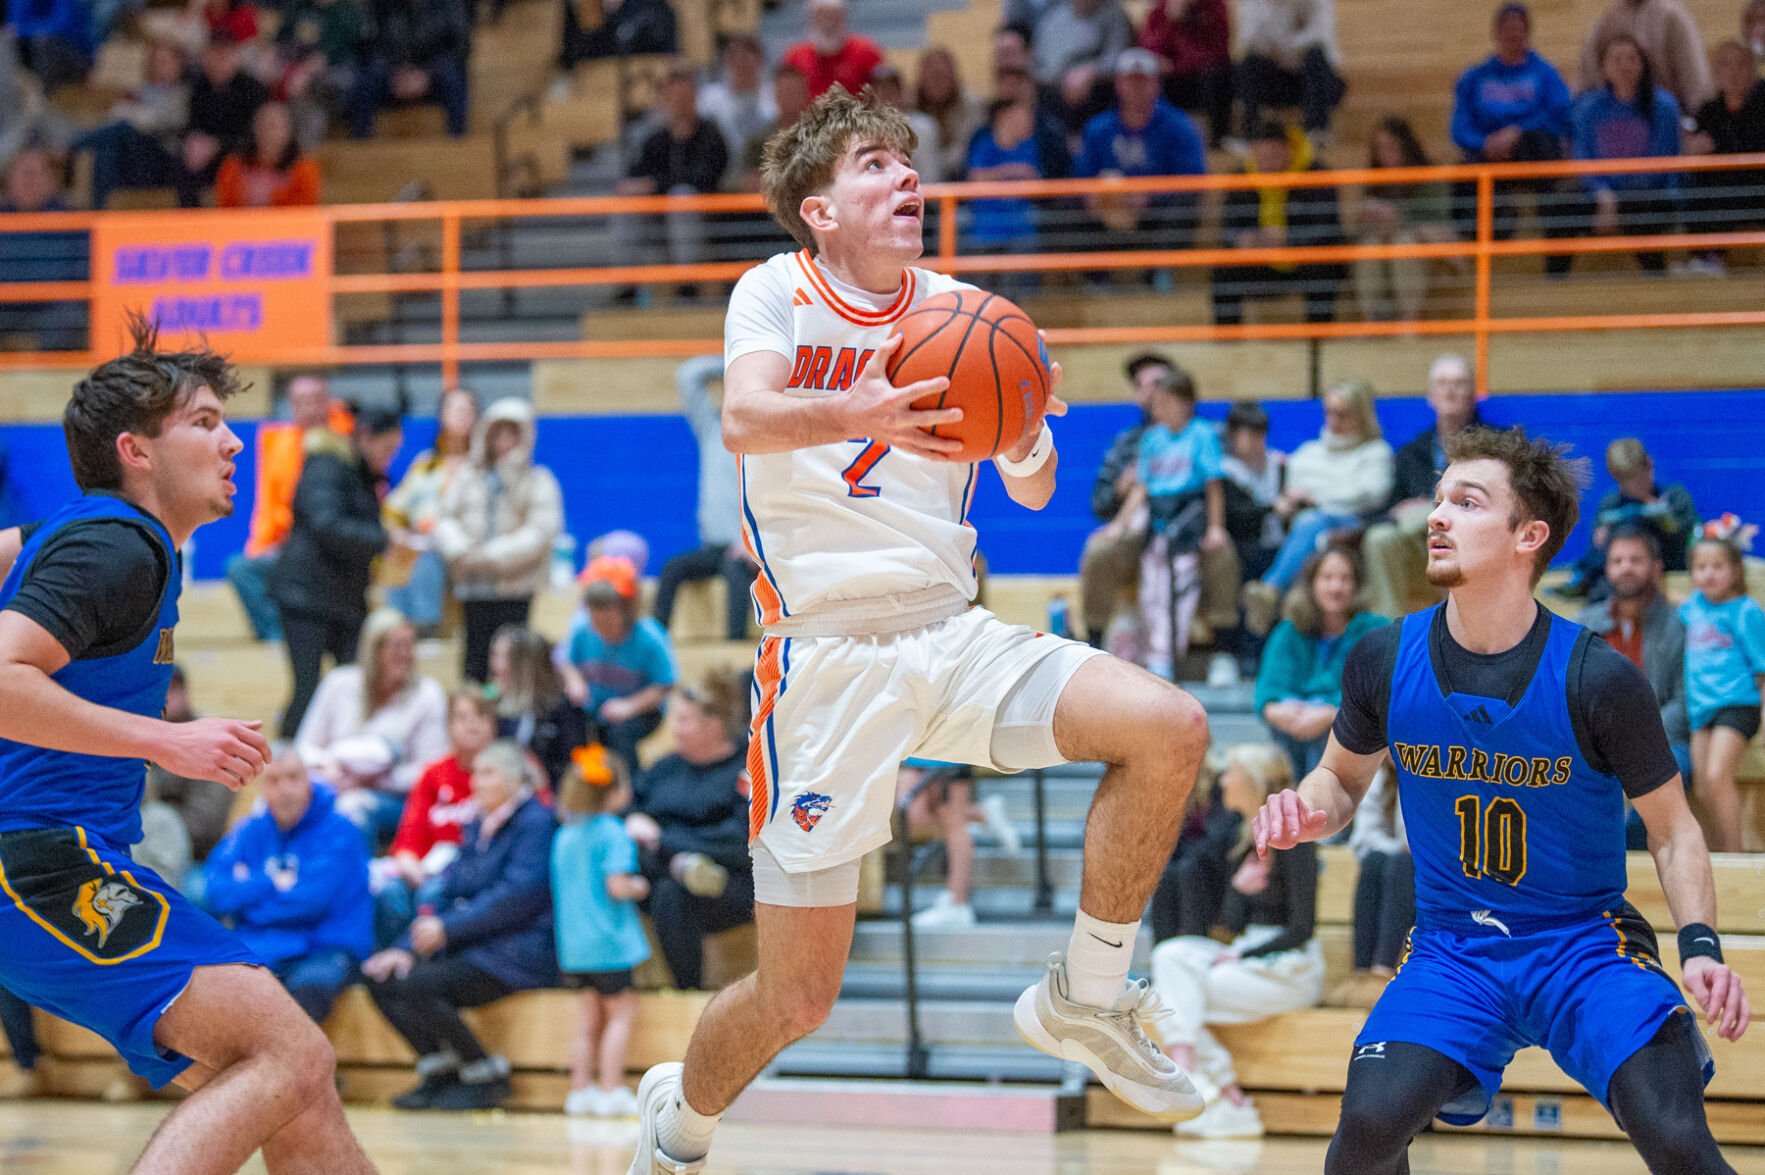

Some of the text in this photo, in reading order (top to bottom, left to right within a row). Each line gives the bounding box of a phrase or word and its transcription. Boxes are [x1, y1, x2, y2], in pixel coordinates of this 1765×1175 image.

[841, 437, 891, 497] 2
[1394, 742, 1572, 788] WARRIORS
[1455, 794, 1527, 887] 10
